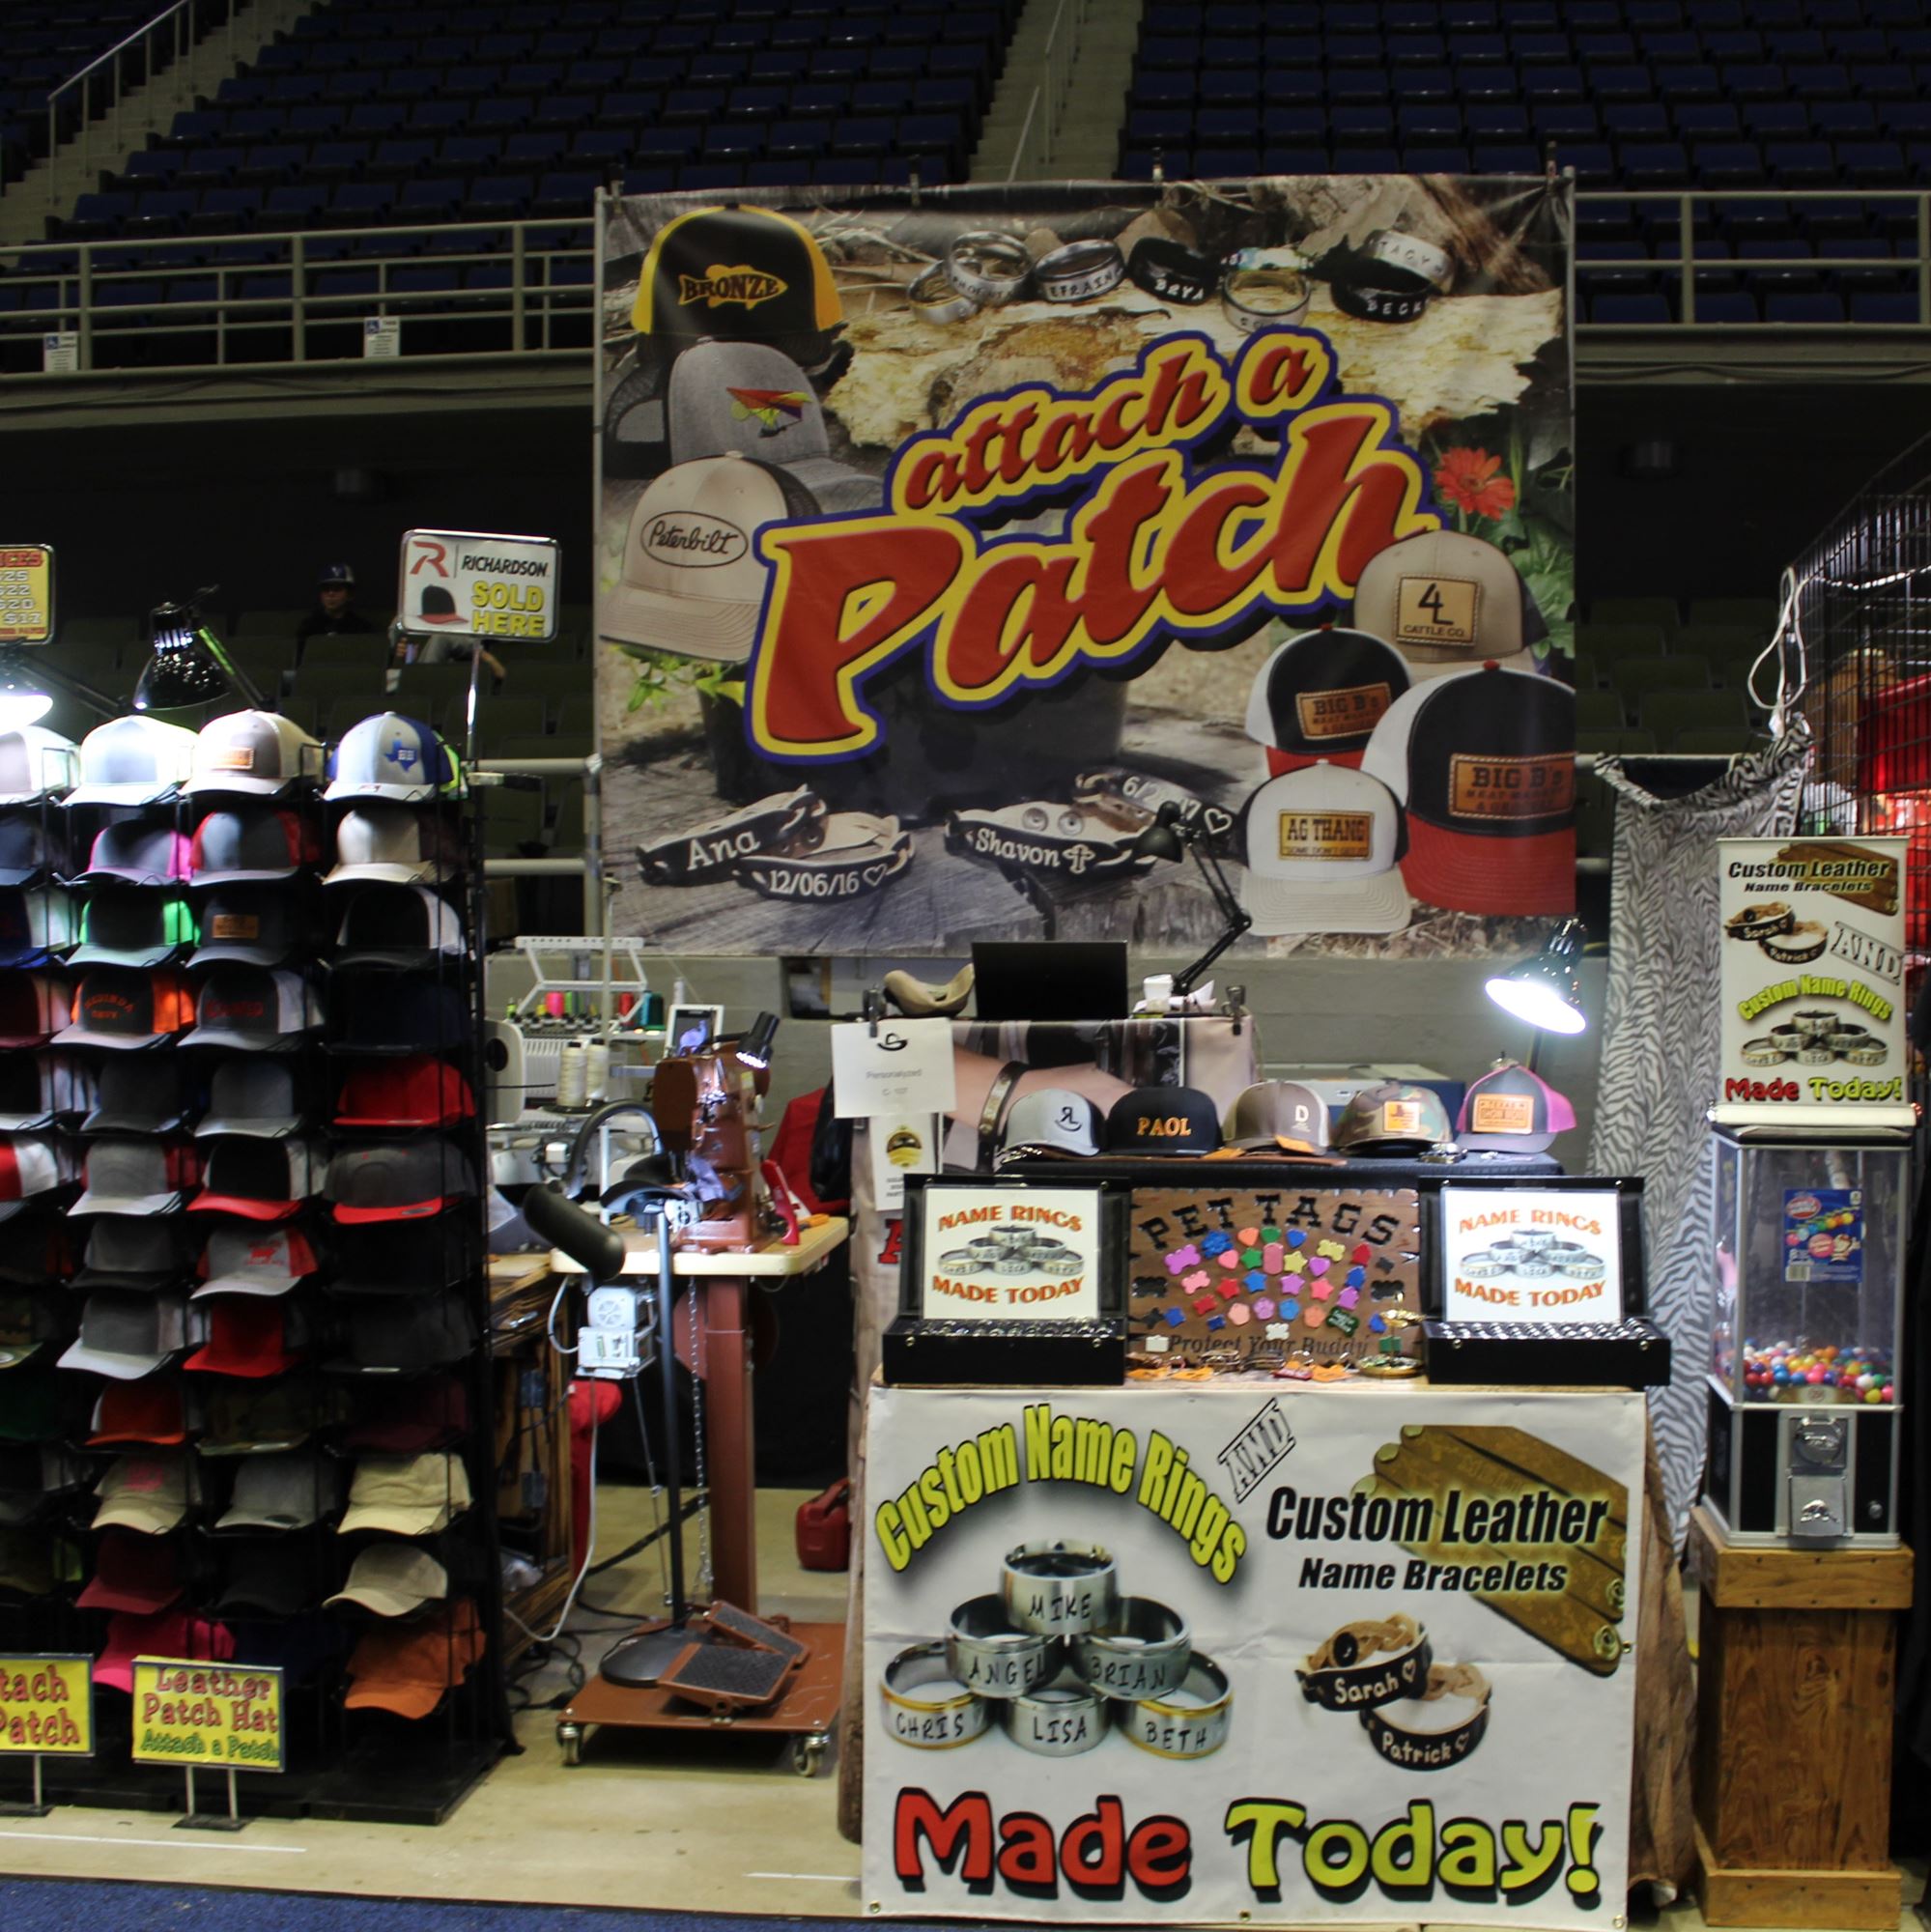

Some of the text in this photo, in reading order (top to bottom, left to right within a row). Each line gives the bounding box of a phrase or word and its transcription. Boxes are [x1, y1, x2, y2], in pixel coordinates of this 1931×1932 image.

[681, 271, 780, 301] BRONZE
[1366, 297, 1429, 316] BECK
[903, 345, 1319, 511] attach a
[647, 520, 742, 555] Peterbilt
[410, 541, 449, 578] R
[461, 555, 549, 577] RICHARDSON
[0, 571, 28, 582] 25
[765, 413, 1432, 745] Patch
[471, 581, 544, 611] SOLD
[472, 610, 546, 638] HERE
[1404, 624, 1446, 636] CATTLE
[1313, 697, 1349, 715] BIG
[1471, 766, 1520, 788] BIG
[1287, 817, 1308, 840] AG
[685, 832, 761, 870] Ana
[975, 828, 1061, 867] Shavon
[769, 868, 860, 897] 12/06/16
[1728, 861, 1890, 879] Custom Leather
[1745, 880, 1873, 893] Name Bracelets
[1832, 924, 1905, 983] AND
[1738, 974, 1894, 1021] Custom Name Rings
[1725, 1075, 1903, 1101] Made Today!
[1136, 1117, 1192, 1137] PAOL
[938, 1206, 1083, 1232] NAME RINGS
[1139, 1194, 1401, 1249] PET TAGS
[1460, 1209, 1603, 1235] NAME RINGS
[932, 1275, 1086, 1304] MADE TODAY
[1454, 1278, 1607, 1307] MADE TODAY
[1169, 1335, 1241, 1352] Protect
[1248, 1335, 1294, 1353] Your
[1220, 1403, 1295, 1501] AND
[875, 1402, 1248, 1585] Custom Name Rings
[1266, 1486, 1610, 1545] Custom Leather
[1298, 1557, 1568, 1592] Name Bracelets
[1028, 1593, 1093, 1623] MIKE
[156, 1666, 271, 1701] Leather
[968, 1657, 1047, 1686] ANGEL
[1090, 1655, 1167, 1690] BRIAN
[1333, 1672, 1399, 1705] Sarah
[142, 1692, 279, 1733] Patch Hat
[895, 1711, 966, 1740] CHRIS
[140, 1729, 206, 1754] Attach
[212, 1739, 222, 1755] a
[1032, 1715, 1089, 1745] LISA
[1145, 1719, 1208, 1752] BETH
[1381, 1727, 1452, 1765] Patrick
[893, 1786, 1604, 1911] Made Today!
